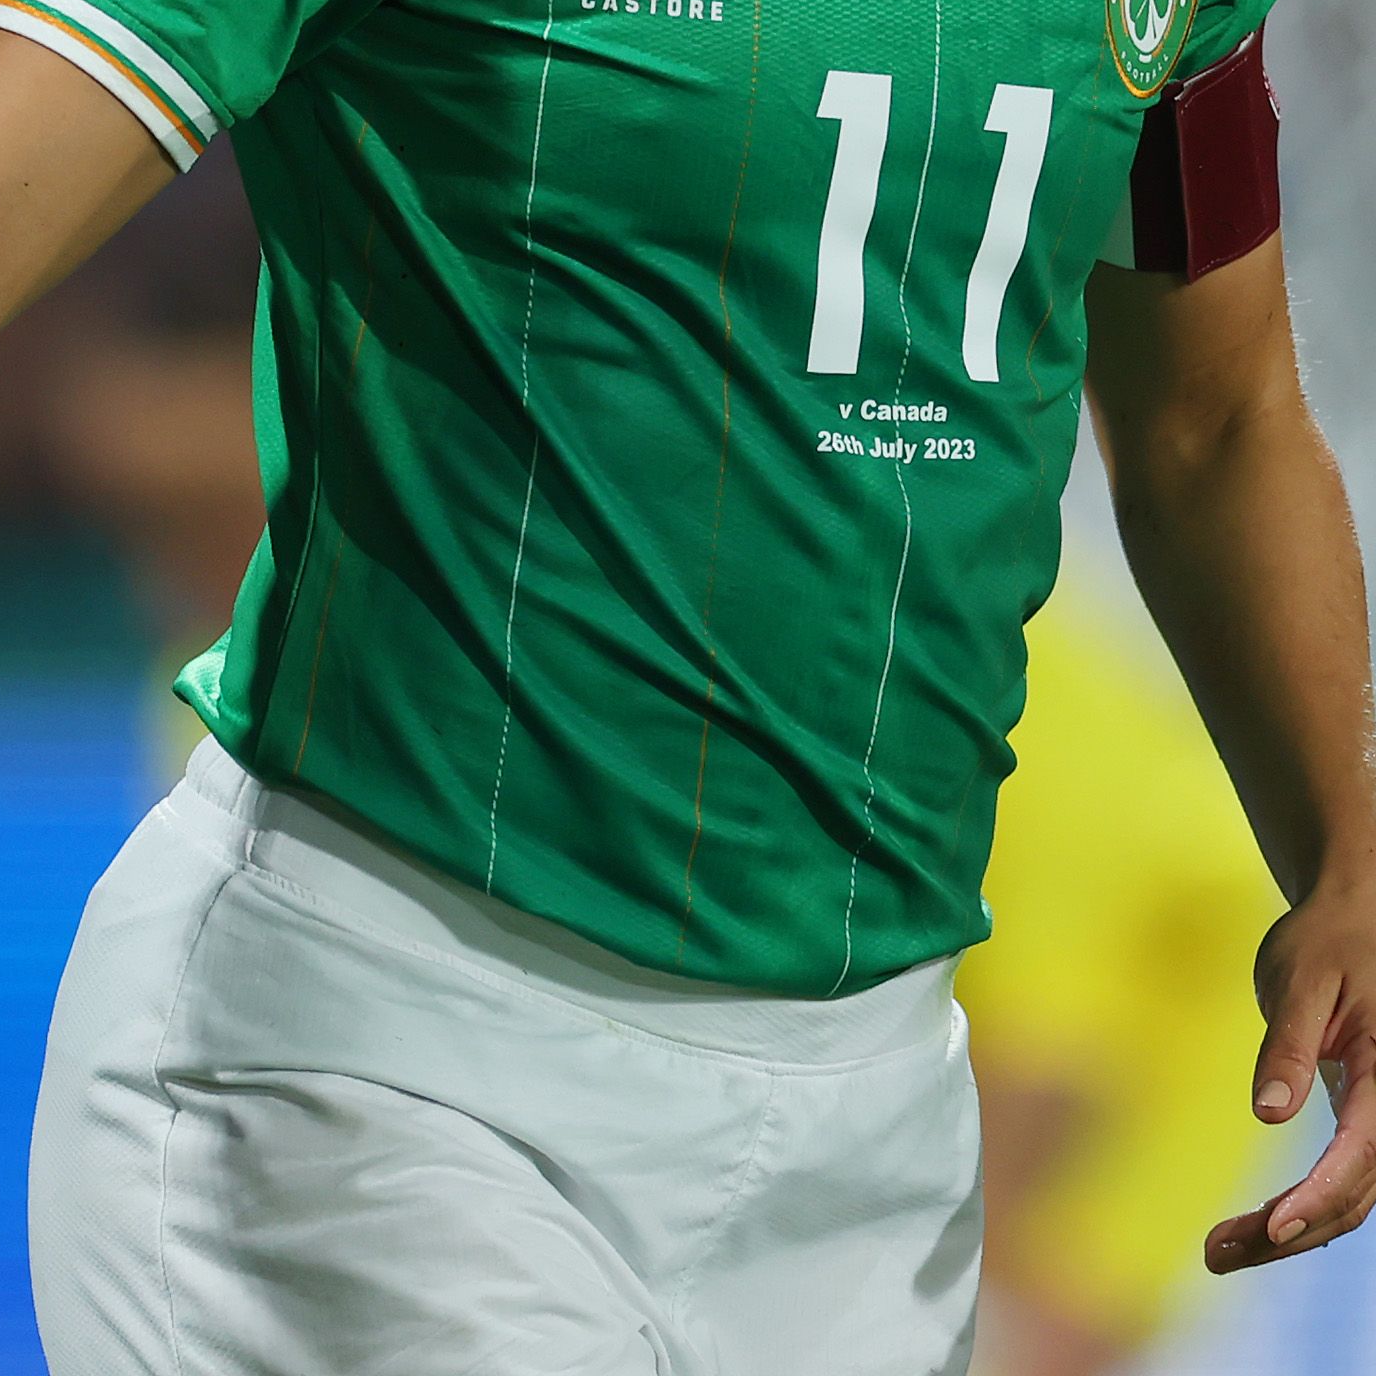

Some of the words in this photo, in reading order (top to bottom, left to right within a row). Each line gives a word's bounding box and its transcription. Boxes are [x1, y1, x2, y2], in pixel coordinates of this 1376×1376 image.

[806, 70, 1055, 383] 11
[839, 403, 853, 420] v
[860, 399, 948, 422] Canada
[816, 430, 865, 456] 26th
[869, 436, 918, 465] July
[923, 438, 976, 460] 2023
